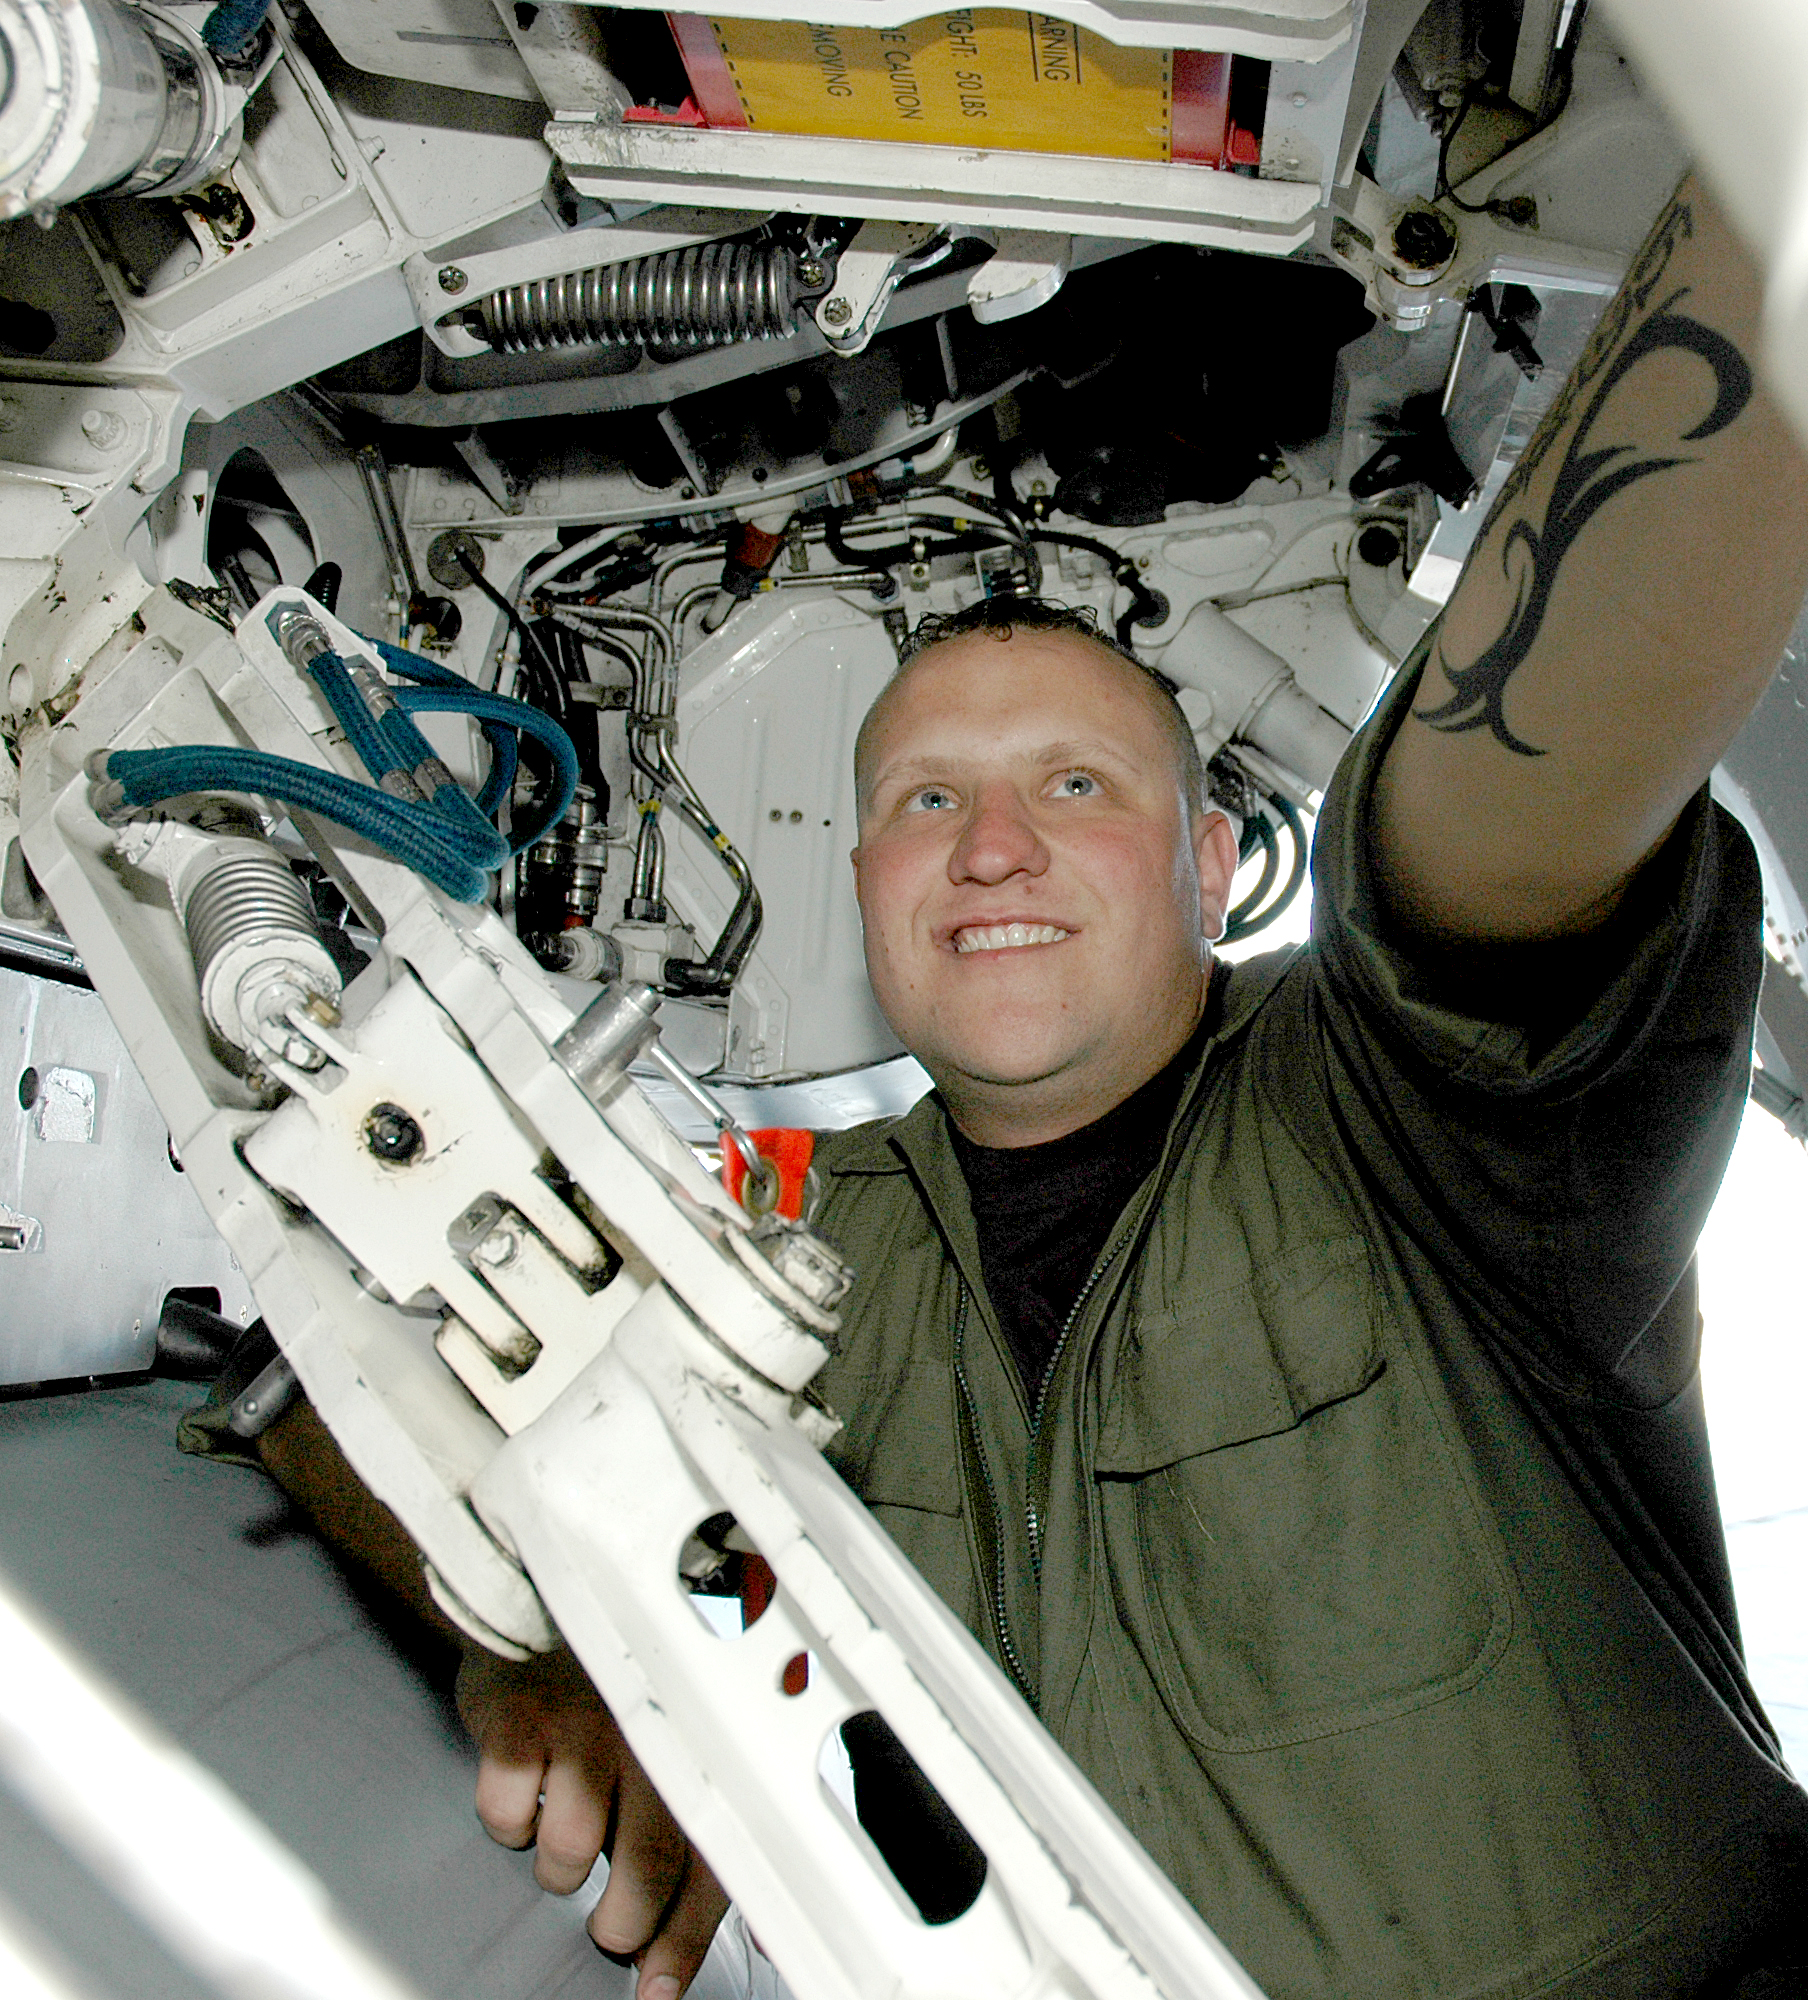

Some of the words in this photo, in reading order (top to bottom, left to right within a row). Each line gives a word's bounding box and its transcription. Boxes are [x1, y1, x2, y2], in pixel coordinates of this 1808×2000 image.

[808, 23, 853, 98] MOVING
[945, 8, 978, 58] EIGHT:
[1039, 13, 1071, 82] ARNING
[884, 51, 924, 120] CAUTION
[955, 70, 983, 92] 50
[960, 93, 988, 119] LBS
